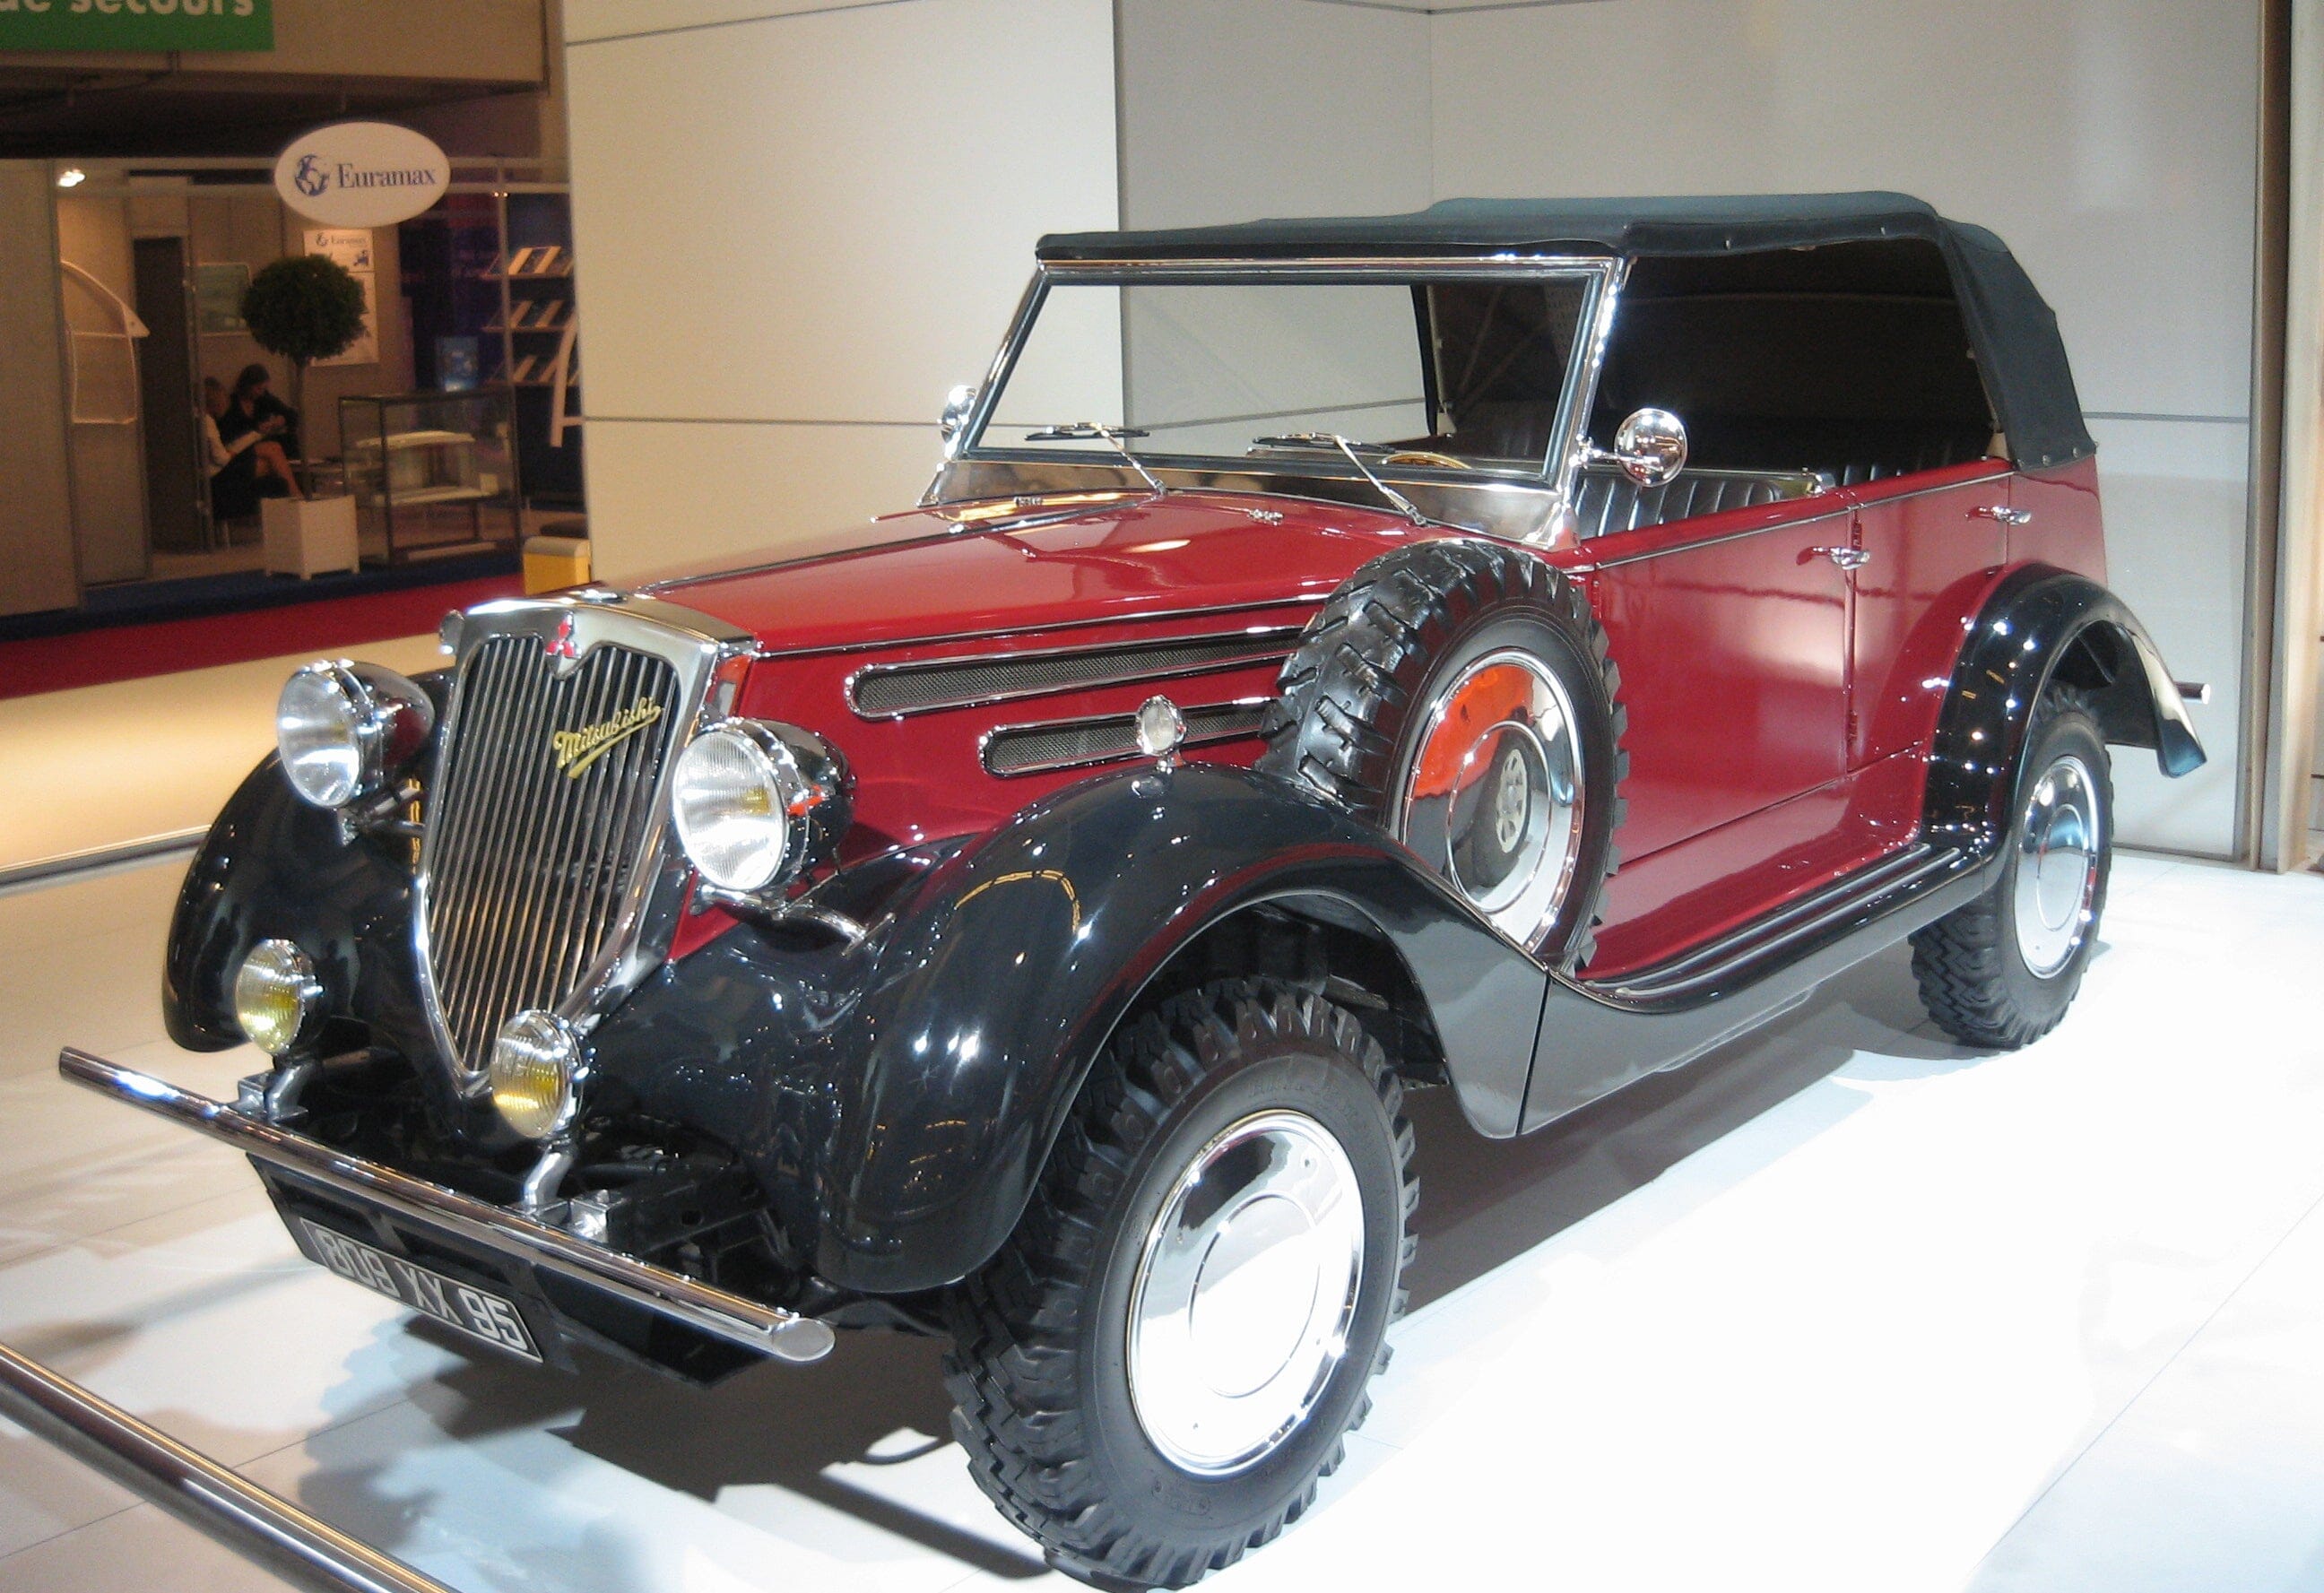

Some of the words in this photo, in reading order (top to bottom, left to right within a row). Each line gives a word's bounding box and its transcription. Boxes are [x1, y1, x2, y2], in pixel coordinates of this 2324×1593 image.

[336, 162, 437, 189] Euramax
[552, 696, 662, 769] Mitsubishi
[457, 1286, 529, 1351] 95
